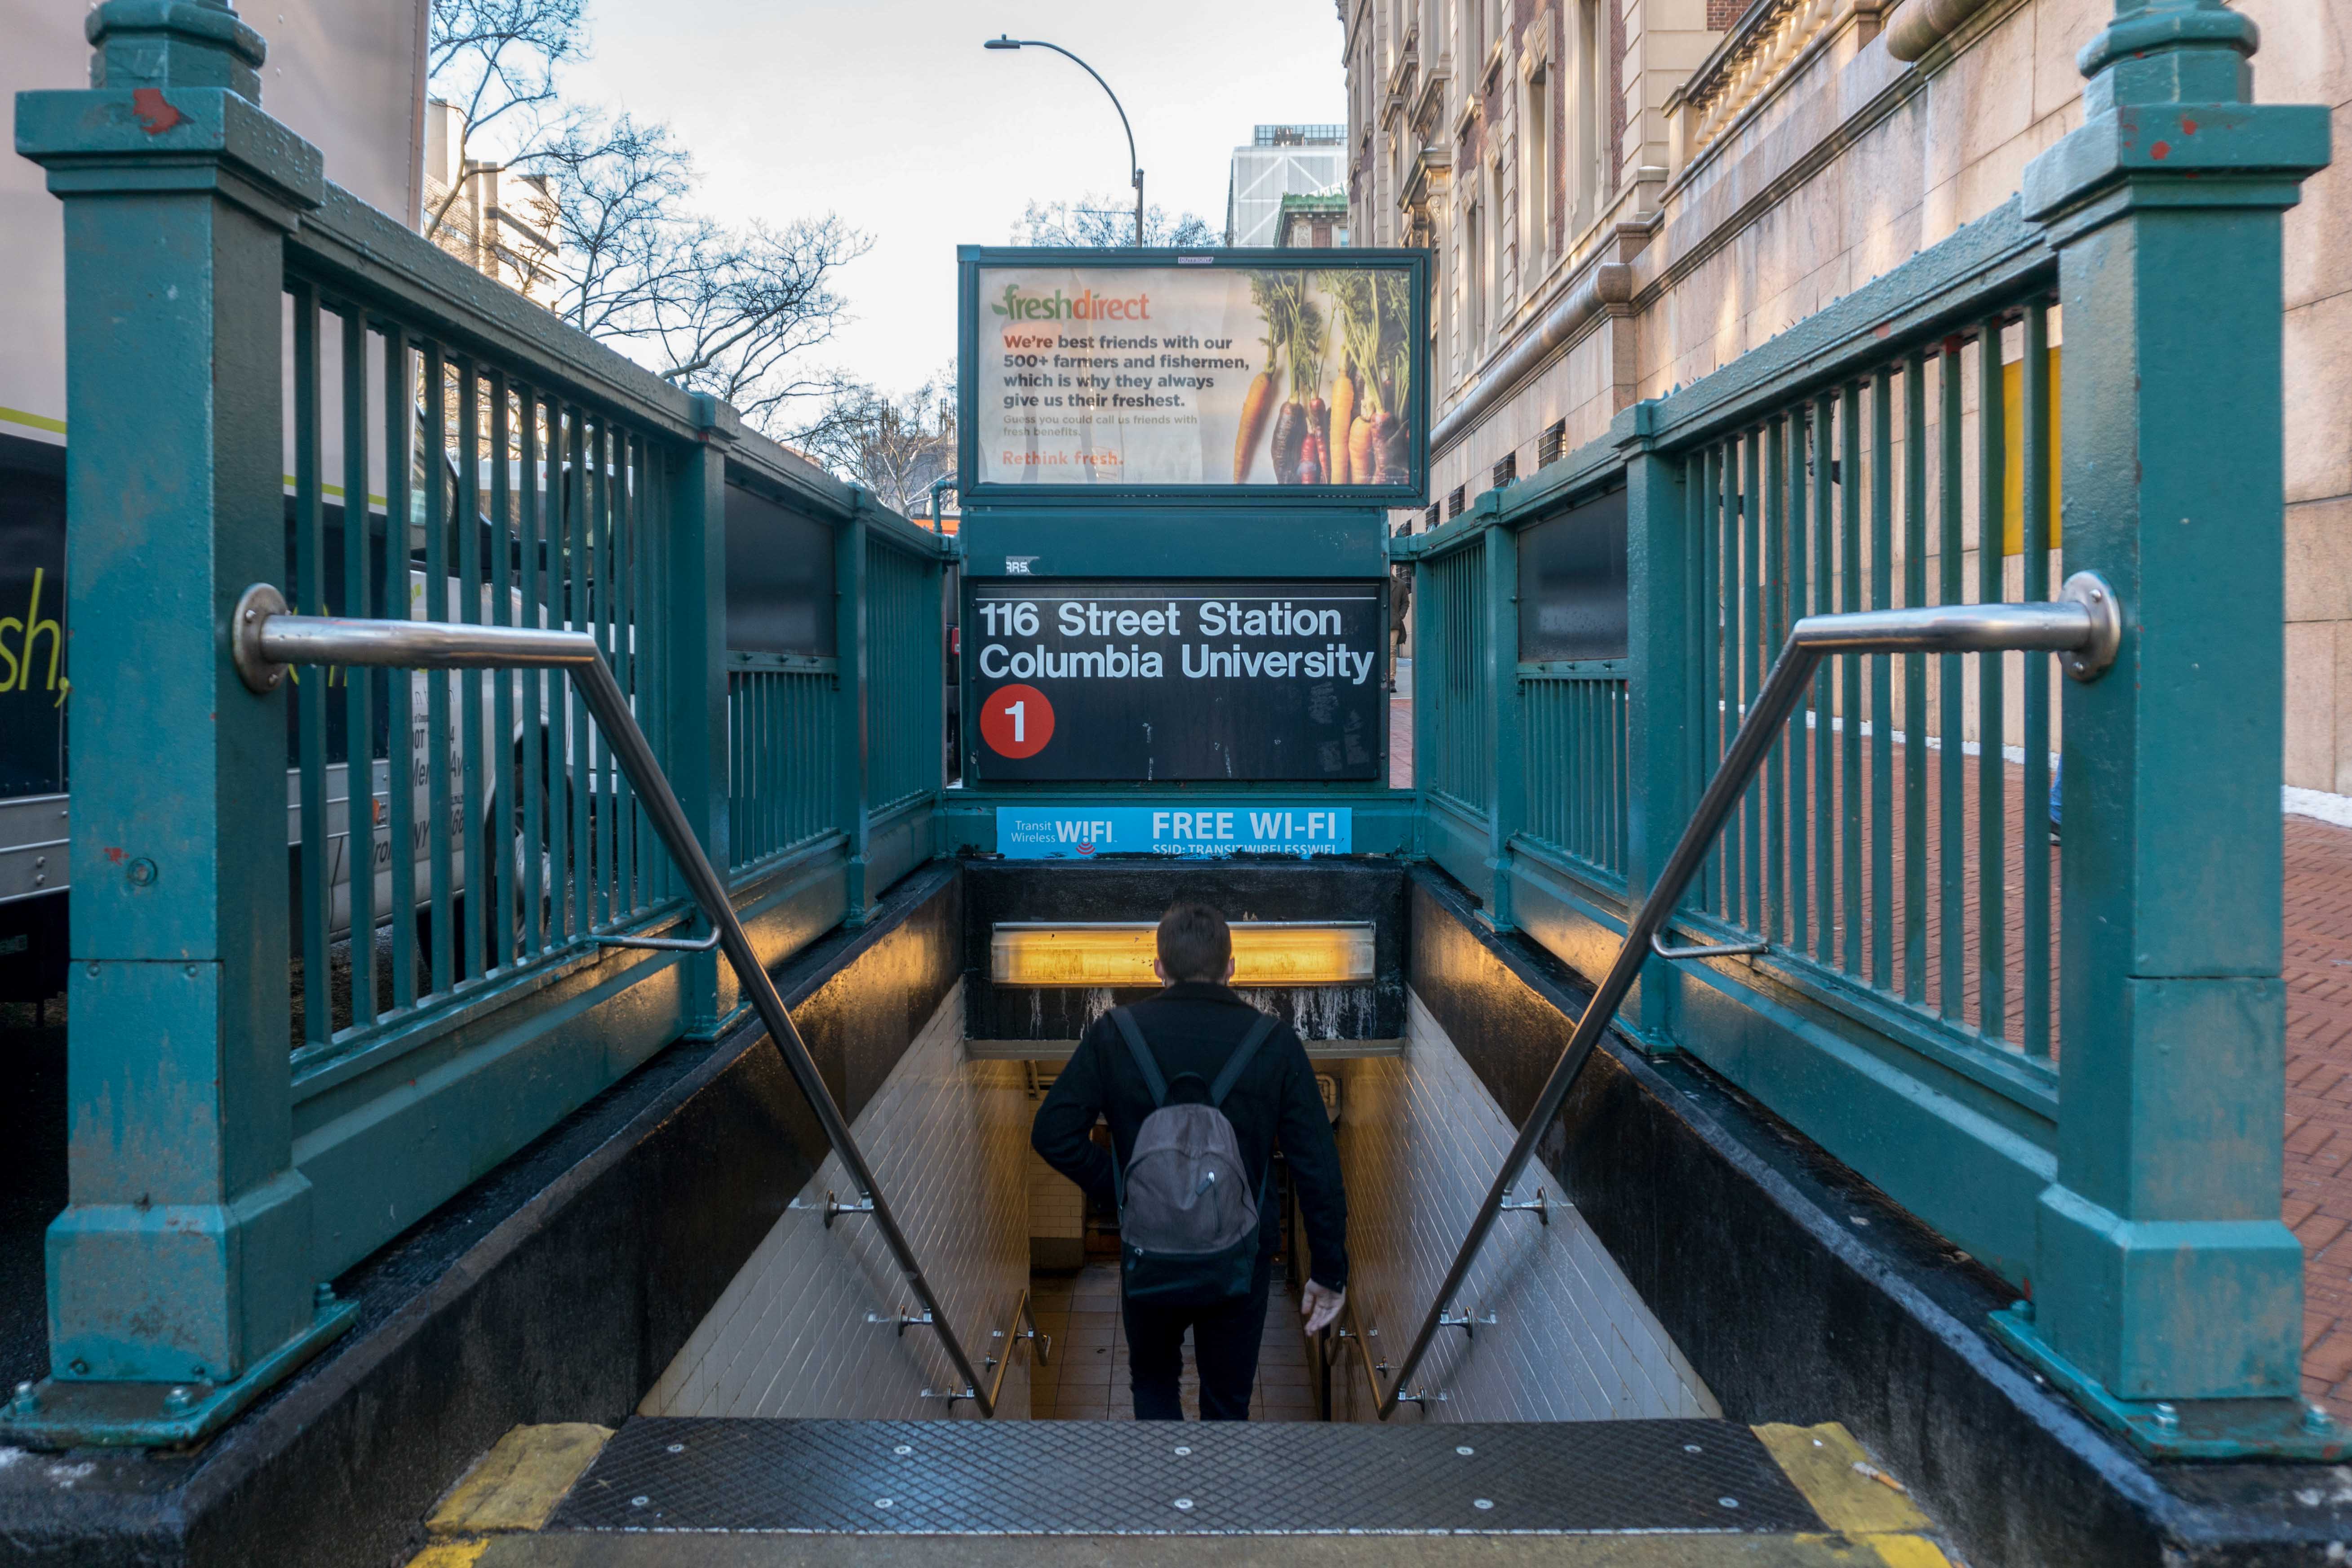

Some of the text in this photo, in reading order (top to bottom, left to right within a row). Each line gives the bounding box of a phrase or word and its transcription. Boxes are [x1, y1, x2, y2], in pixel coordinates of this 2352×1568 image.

[1003, 284, 1149, 320] freshdirect
[1004, 335, 1232, 349] We're best friends with our
[1003, 355, 1249, 371] 500+ farmers and fishermen,
[1003, 373, 1214, 390] which is why they always
[1003, 393, 1185, 409] give us their freshest.
[1003, 415, 1036, 424] Guess
[1039, 416, 1059, 425] you
[1062, 415, 1092, 424] could
[1096, 415, 1114, 424] call
[1134, 415, 1170, 424] friends
[1174, 415, 1197, 424] with
[1003, 427, 1081, 436] fresh benefits.
[1003, 450, 1124, 465] Rethink fresh.
[980, 602, 1341, 636] 116 Street Station
[980, 644, 1375, 685] Columbia University
[1005, 701, 1024, 742] 1
[1015, 821, 1052, 831] Transit
[1153, 812, 1336, 839] FREE WI-FI
[1011, 833, 1056, 843] Wireless
